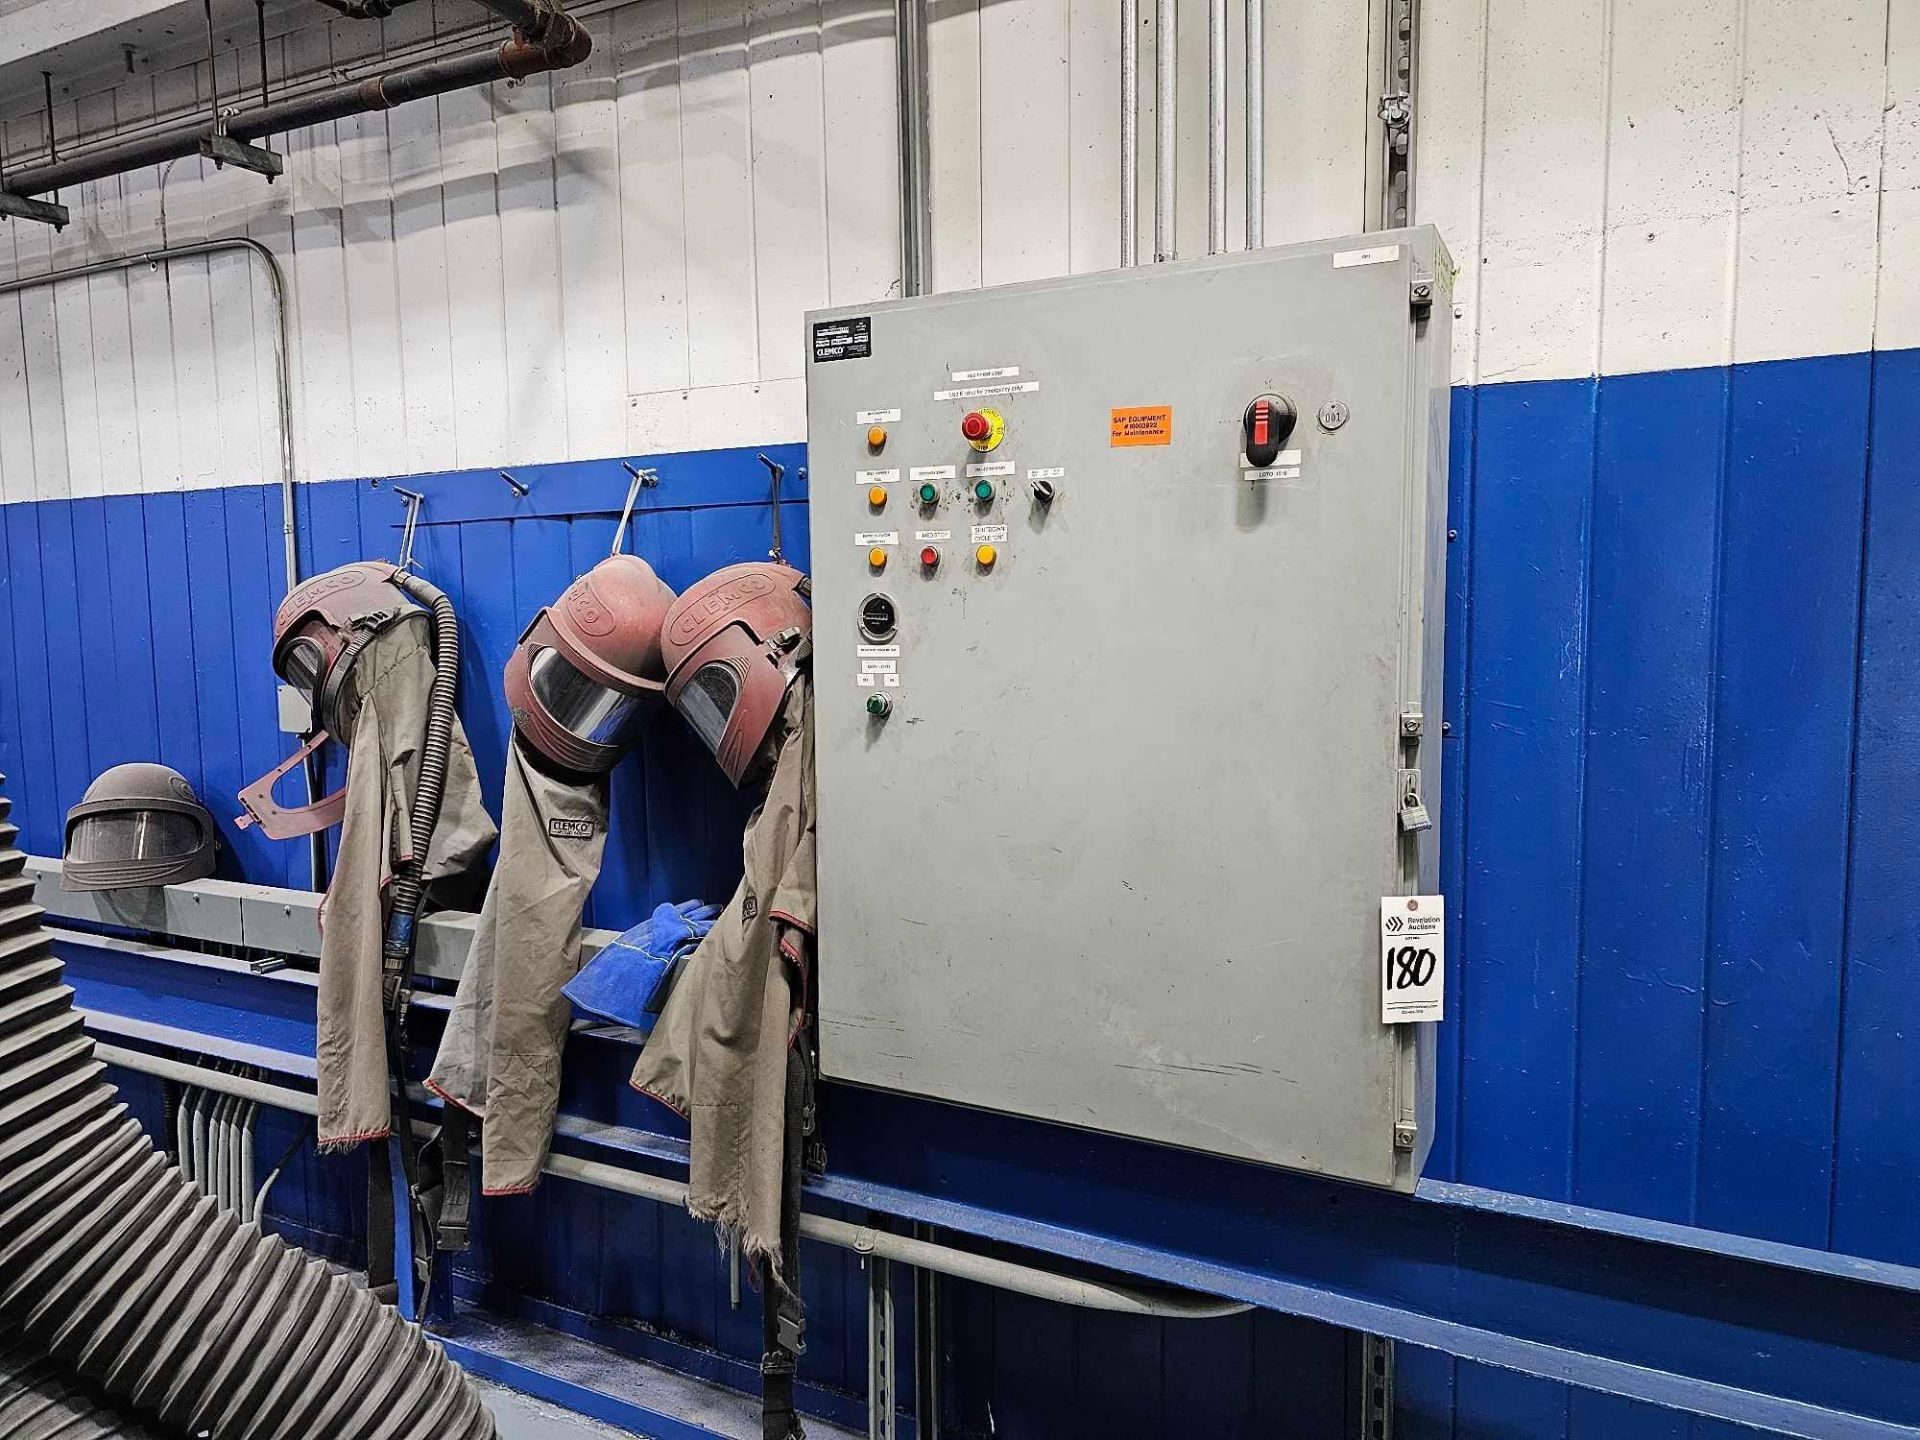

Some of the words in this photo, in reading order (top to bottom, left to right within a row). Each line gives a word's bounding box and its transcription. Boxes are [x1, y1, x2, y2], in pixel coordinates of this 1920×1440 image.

[1129, 414, 1166, 423] EQUIPMENT
[1325, 412, 1341, 423] 001
[681, 581, 766, 634] CLEMCO
[553, 821, 589, 832] CLEMCO
[1387, 946, 1436, 990] 180
